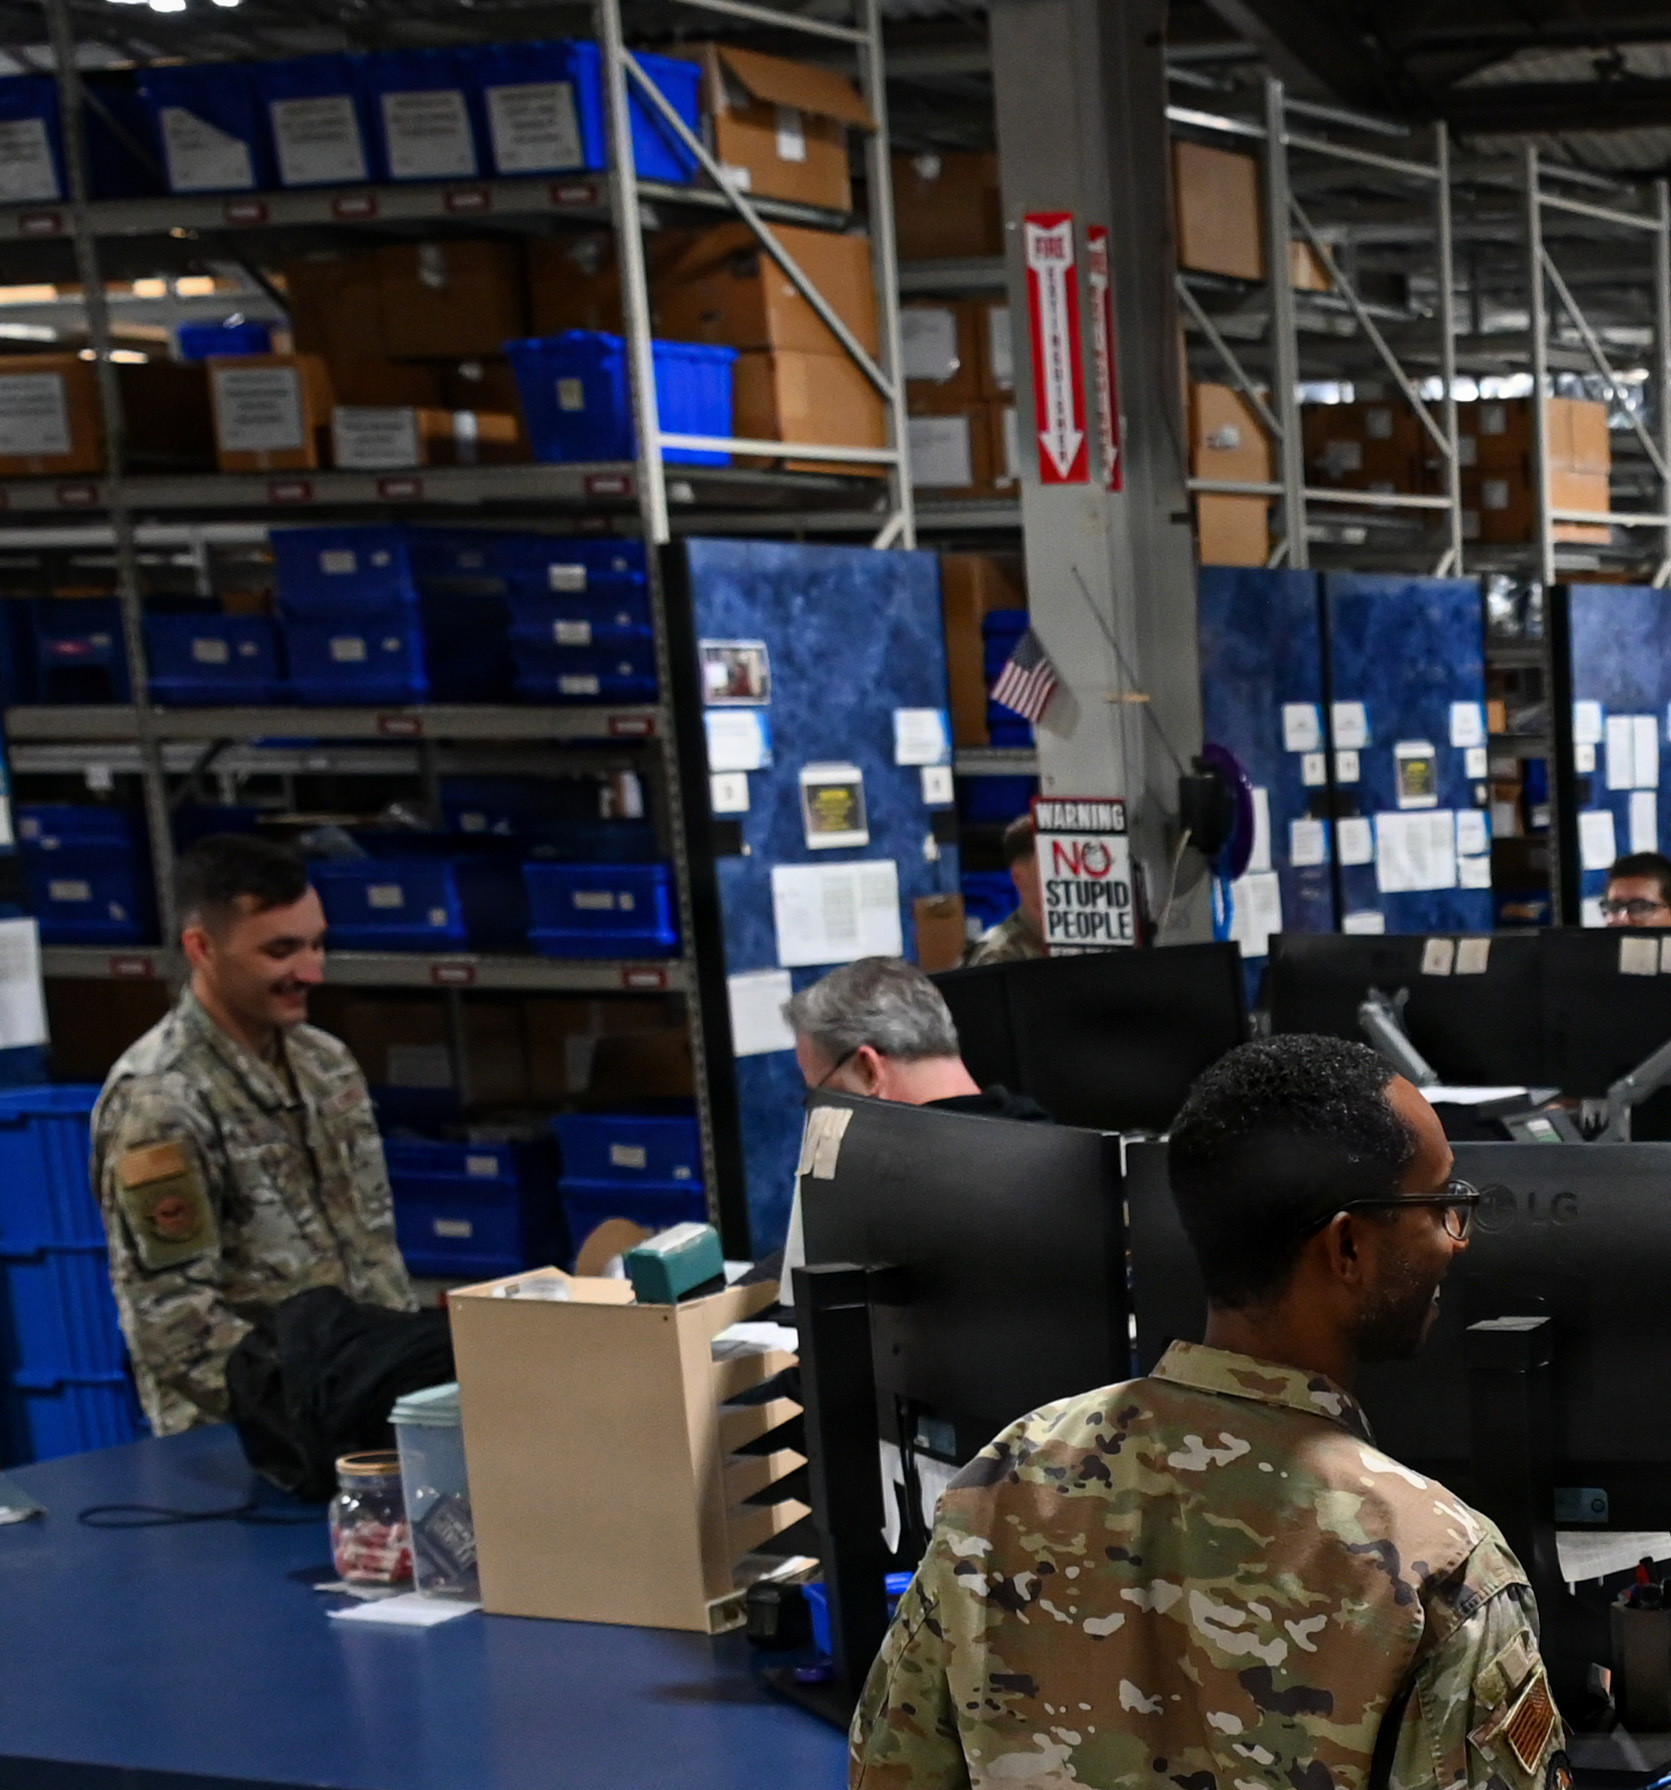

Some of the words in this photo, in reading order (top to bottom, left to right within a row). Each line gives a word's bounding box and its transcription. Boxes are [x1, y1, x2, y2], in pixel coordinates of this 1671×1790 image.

[1035, 803, 1125, 830] WARNING
[1052, 840, 1112, 879] NO
[1046, 880, 1129, 909] STUPID
[1048, 910, 1133, 939] PEOPLE
[1527, 1191, 1578, 1226] LG
